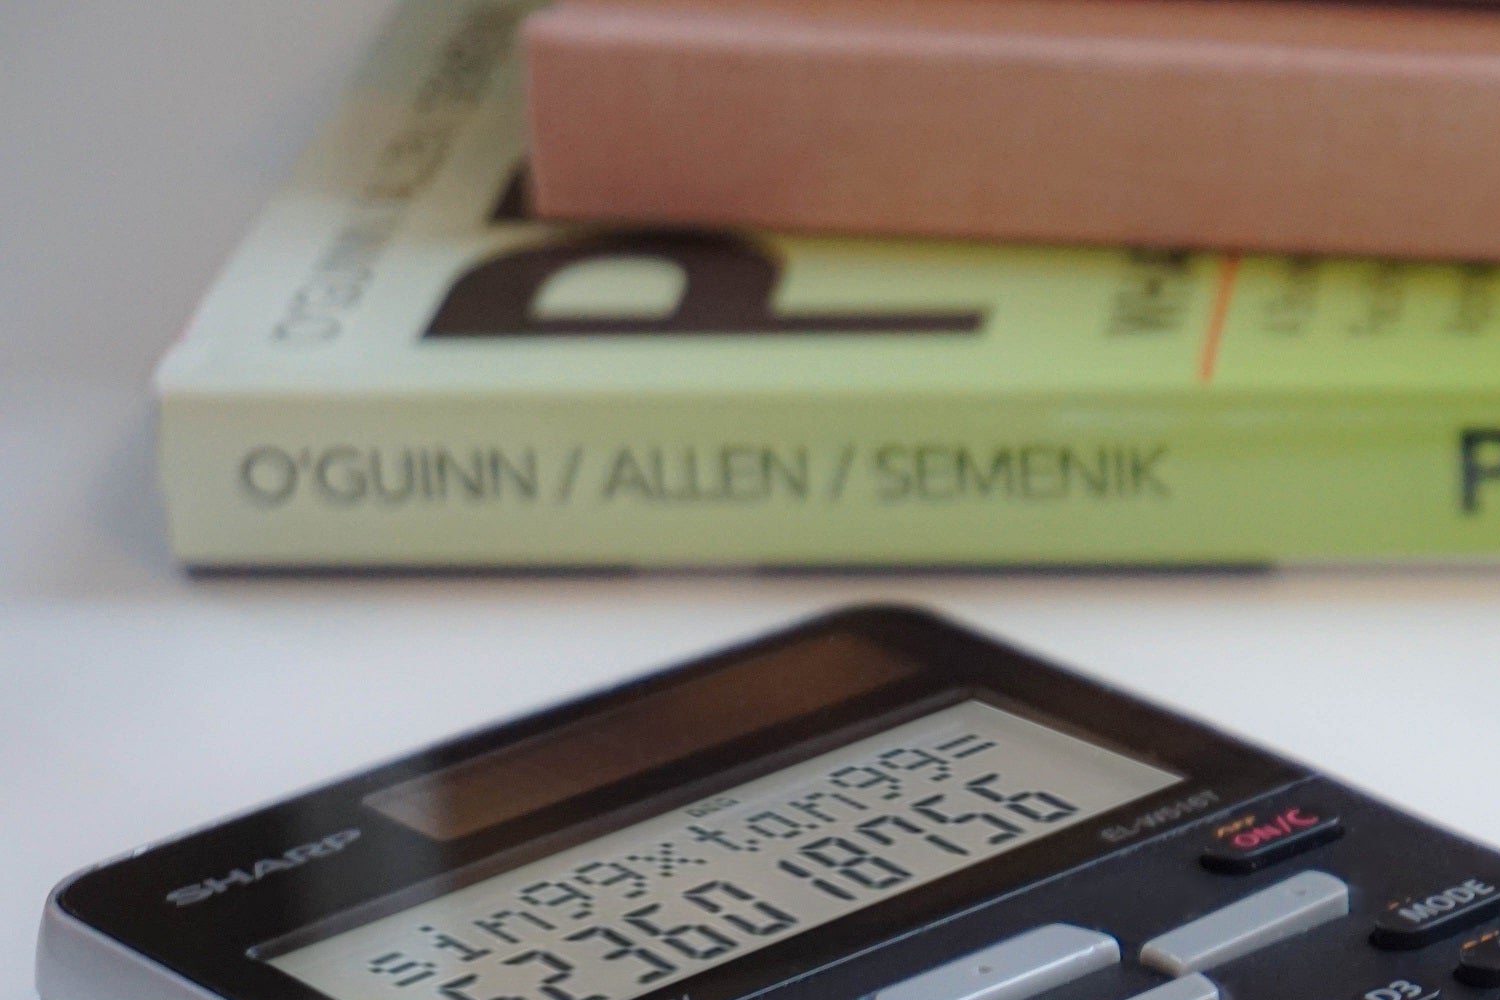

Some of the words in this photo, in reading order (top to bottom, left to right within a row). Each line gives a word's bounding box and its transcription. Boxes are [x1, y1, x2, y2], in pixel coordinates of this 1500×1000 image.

[239, 443, 538, 507] O'GUINN
[603, 445, 809, 503] ALLEN
[873, 442, 1172, 504] SEMENIK
[1232, 808, 1320, 849] ON/C
[168, 829, 361, 906] SHARP
[1401, 879, 1494, 922] MODE
